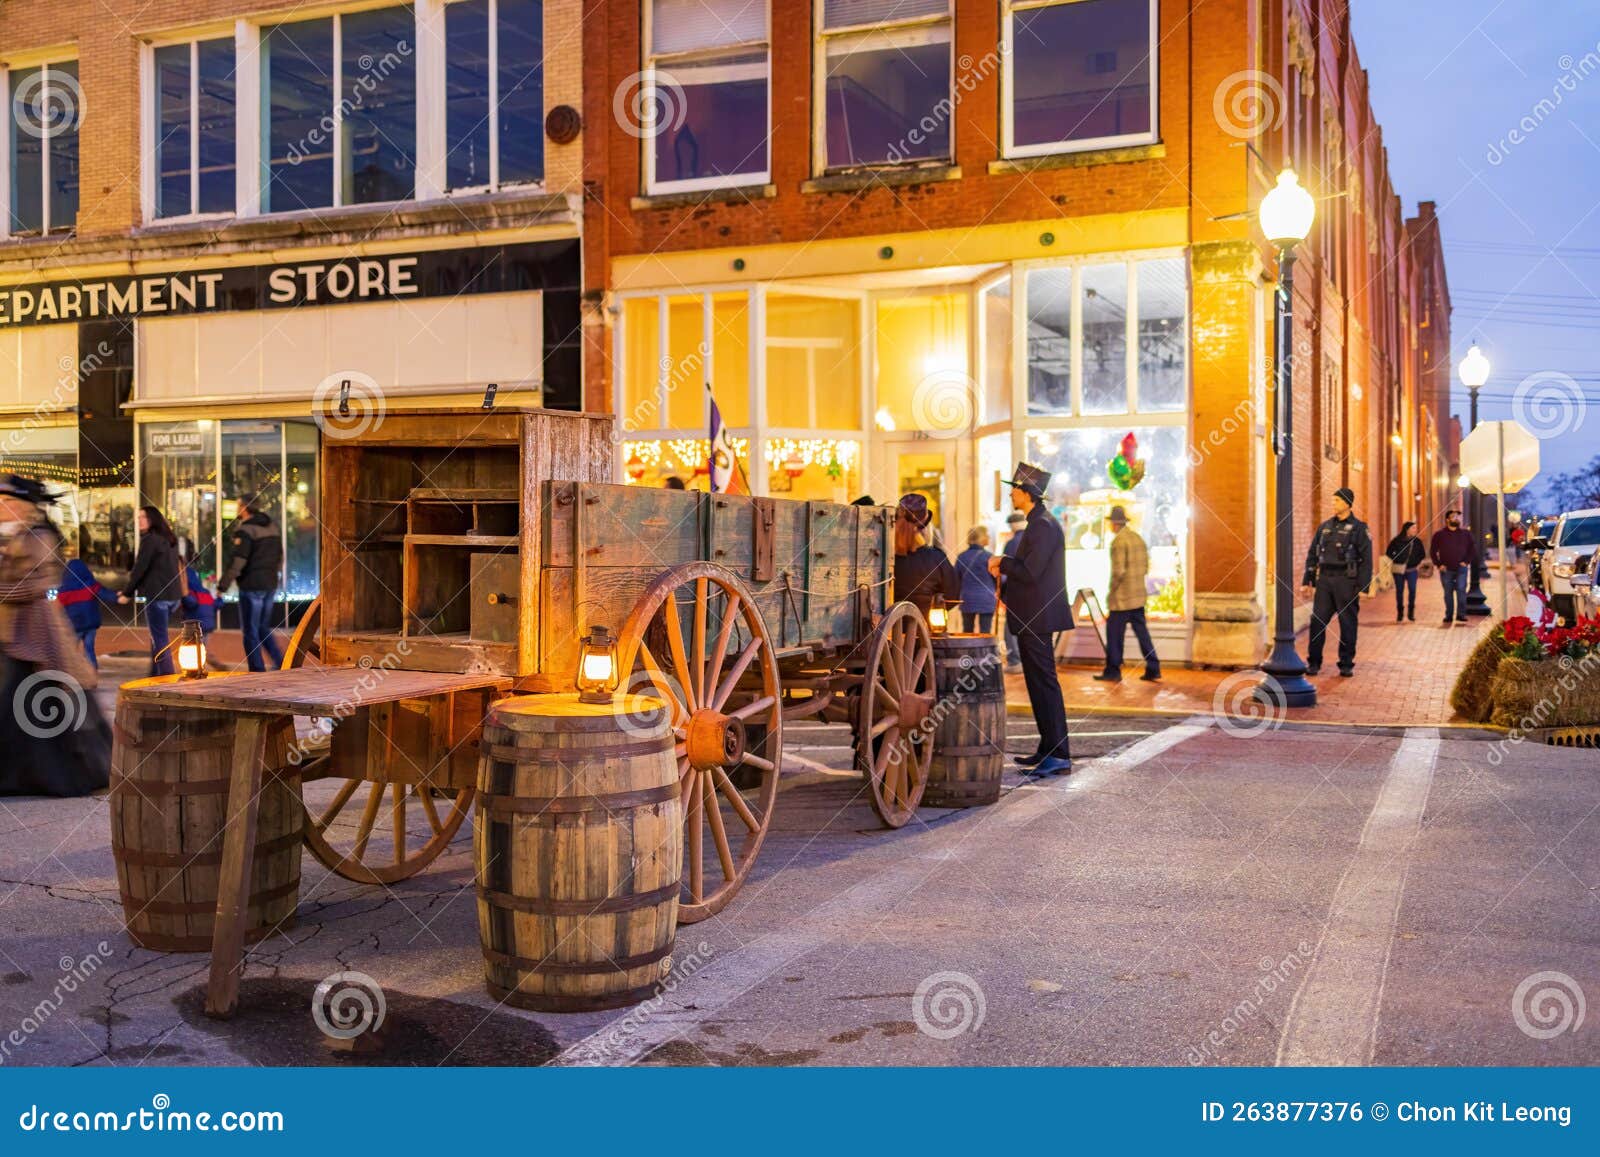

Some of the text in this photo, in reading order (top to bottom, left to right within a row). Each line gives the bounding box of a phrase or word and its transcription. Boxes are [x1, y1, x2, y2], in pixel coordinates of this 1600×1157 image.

[269, 257, 418, 302] STORE
[153, 433, 201, 446] FOR LEASE
